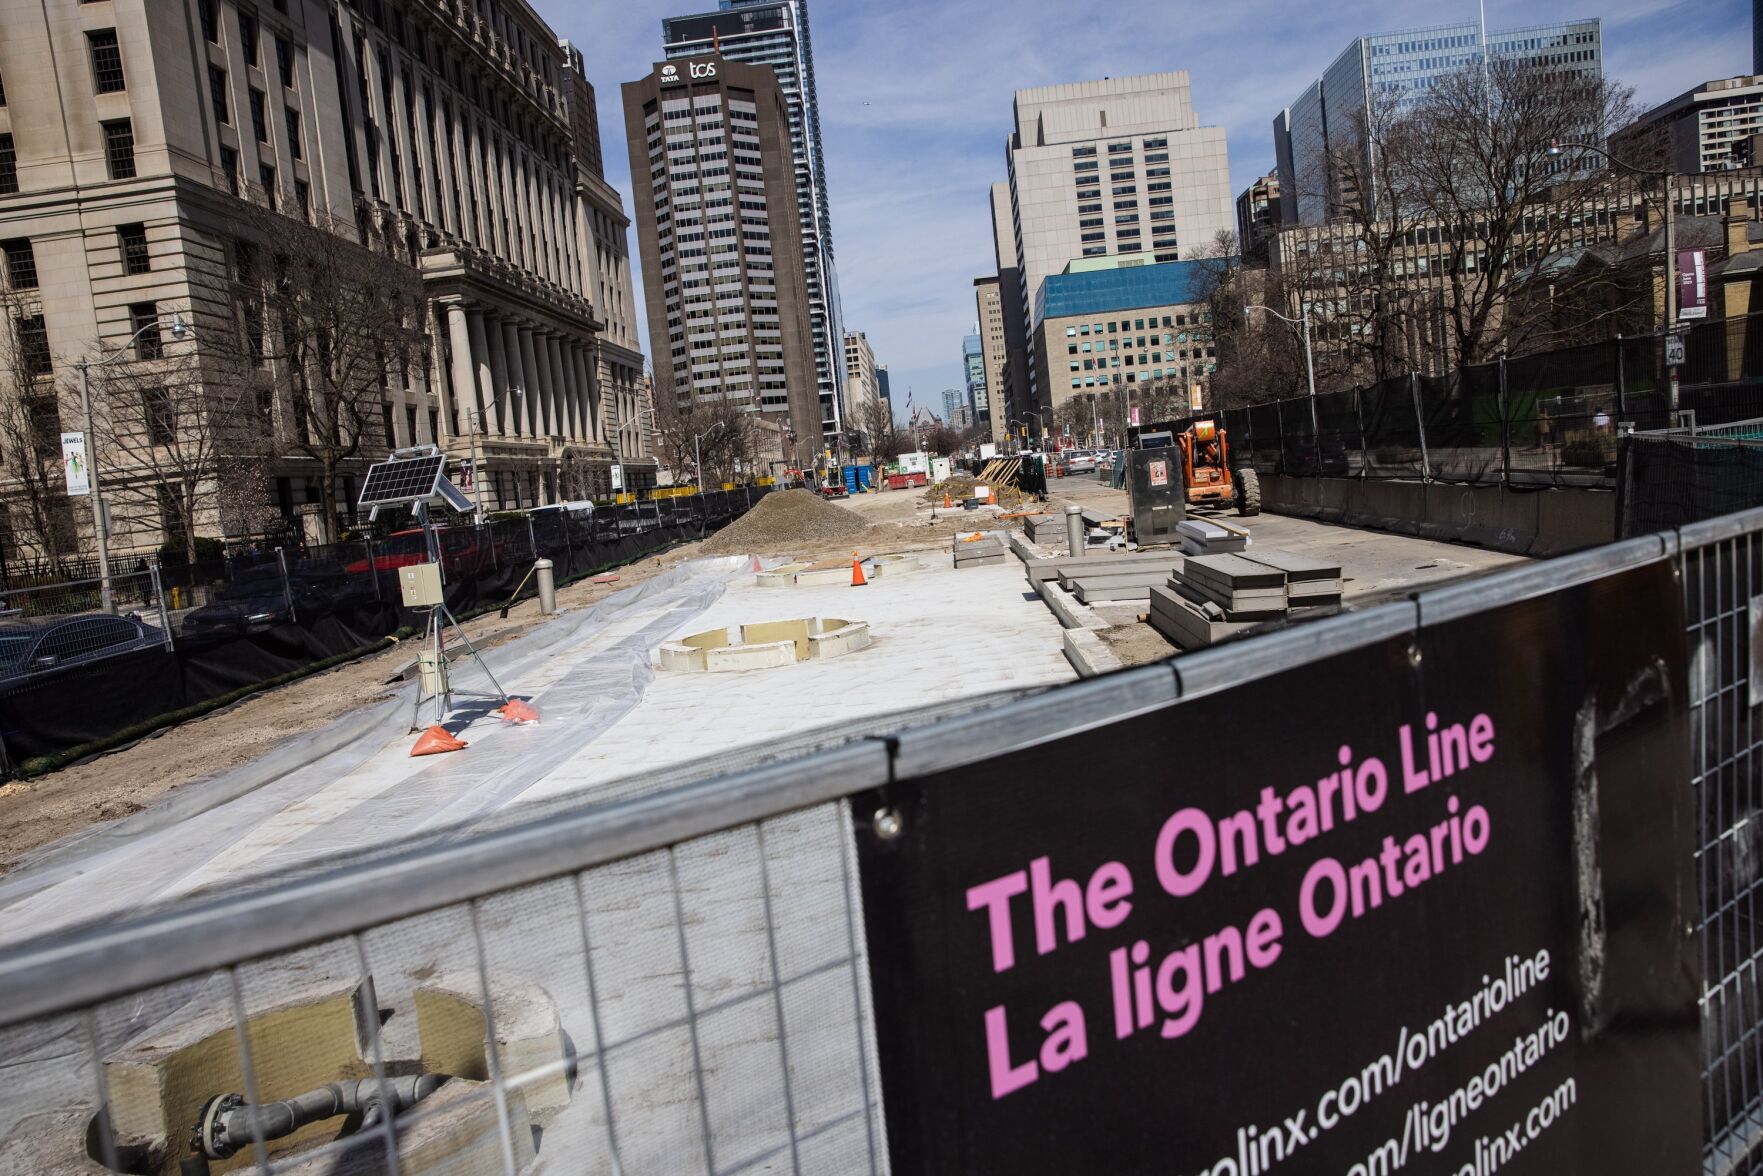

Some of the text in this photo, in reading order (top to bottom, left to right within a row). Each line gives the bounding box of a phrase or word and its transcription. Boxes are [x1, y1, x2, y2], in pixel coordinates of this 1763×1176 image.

[690, 62, 716, 78] tcs
[1669, 348, 1683, 359] 40
[966, 712, 1494, 972] The Ontario Line
[985, 796, 1490, 1098] La ligne Ontario
